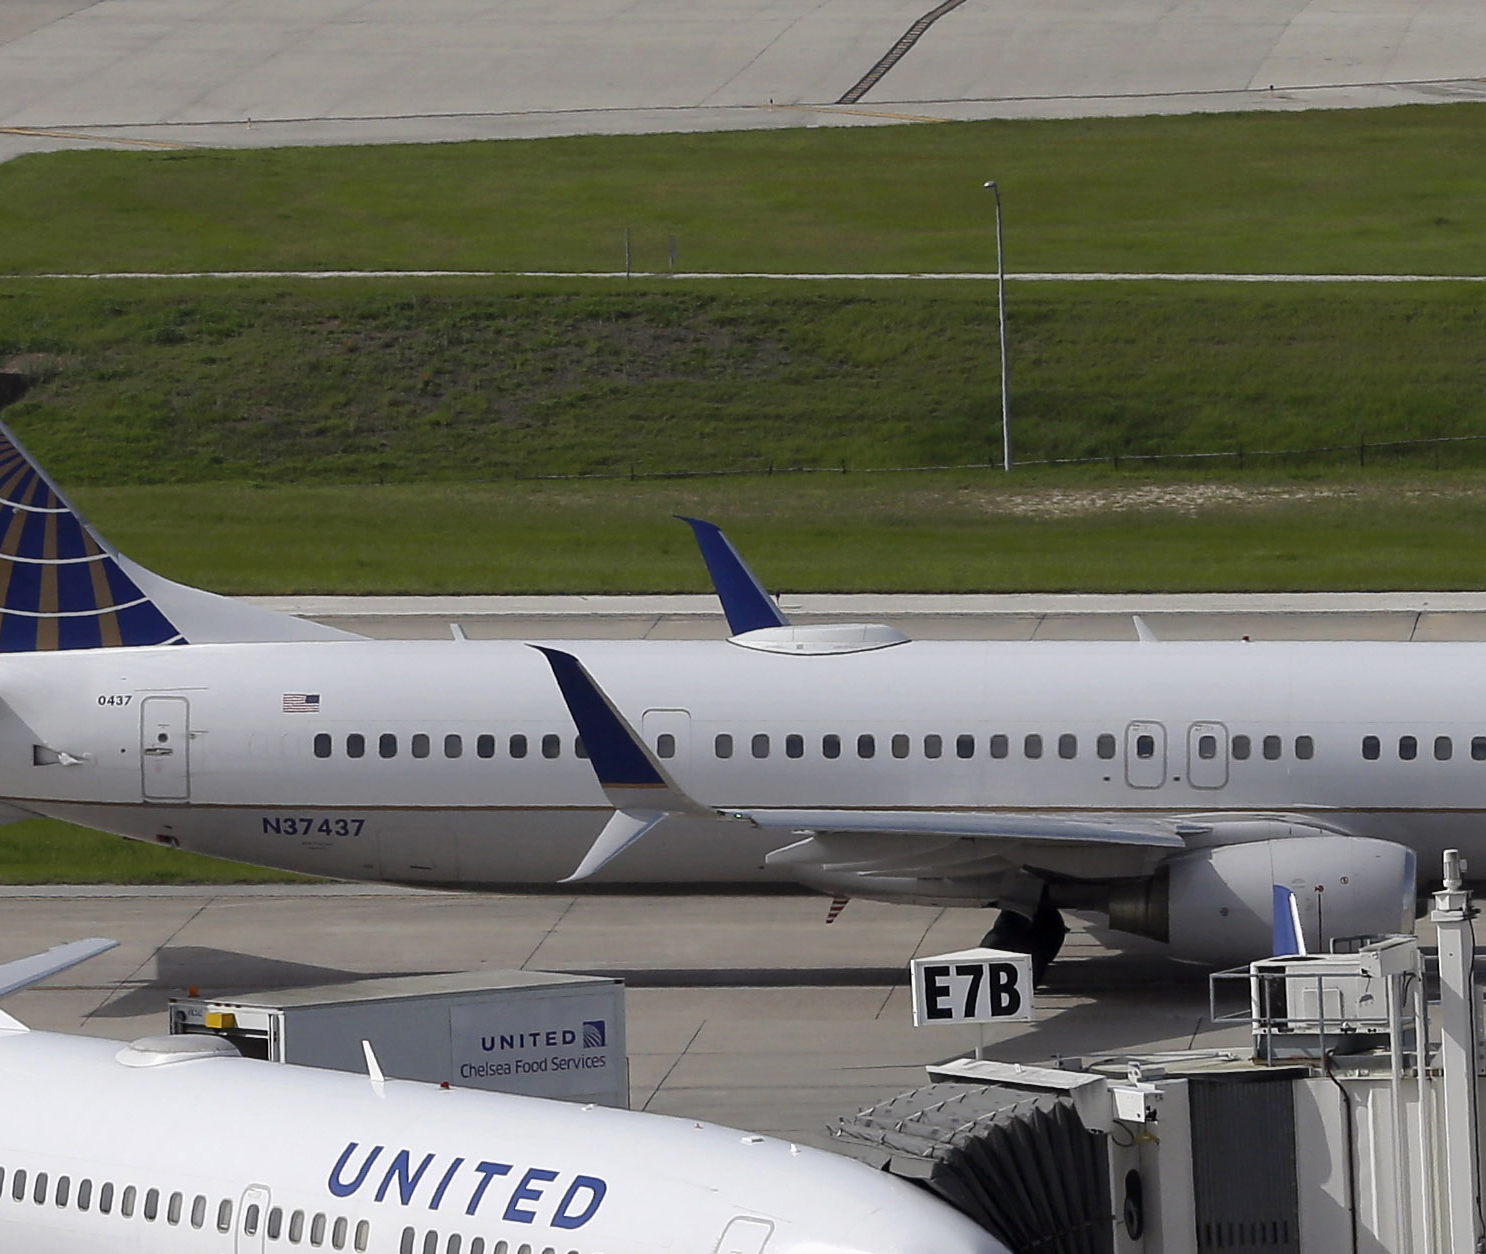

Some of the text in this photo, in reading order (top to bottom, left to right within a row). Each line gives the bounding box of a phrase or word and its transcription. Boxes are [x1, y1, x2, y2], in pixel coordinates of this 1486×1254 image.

[98, 695, 132, 706] 0437
[262, 817, 366, 836] N37437
[923, 962, 1022, 1020] E7B
[481, 1029, 577, 1052] UNITED
[460, 1054, 606, 1078] Chelsea Food Services
[327, 1141, 608, 1231] UNITED
